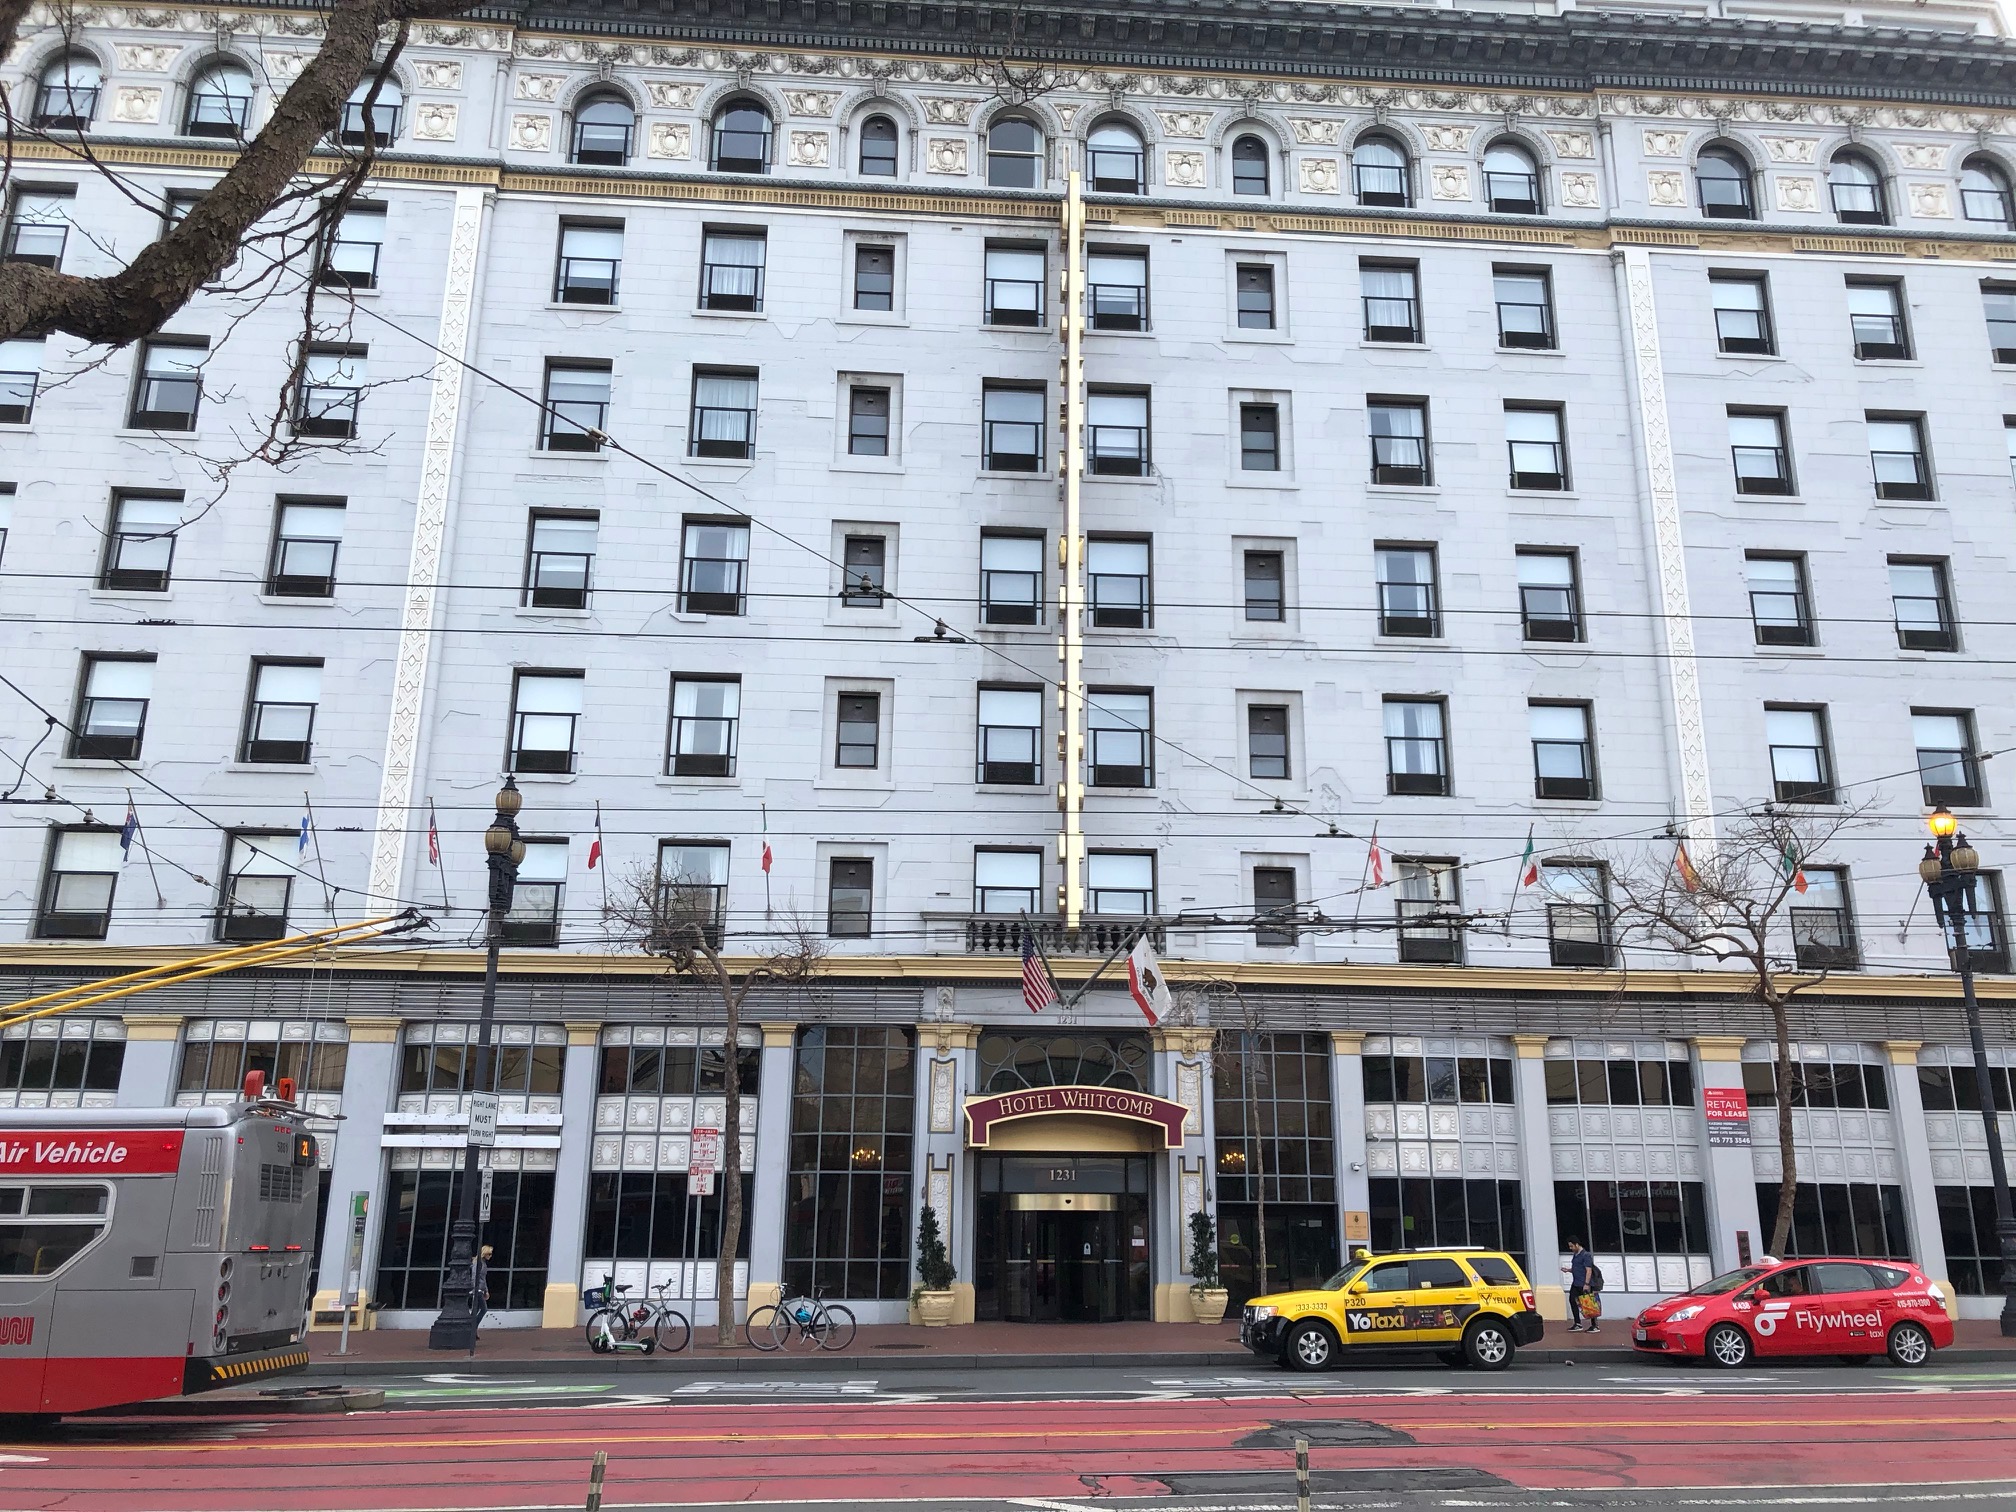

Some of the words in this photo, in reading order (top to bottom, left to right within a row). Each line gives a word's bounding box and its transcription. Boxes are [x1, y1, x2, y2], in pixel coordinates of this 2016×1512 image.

[1056, 1015, 1077, 1025] 1231
[486, 1102, 497, 1110] LANE
[999, 1094, 1056, 1116] HOTEL
[1060, 1090, 1154, 1116] WHITCOMB
[1706, 1100, 1742, 1109] RETAIL
[475, 1114, 492, 1124] MUST
[470, 1129, 481, 1137] TURN
[482, 1130, 494, 1138] RIGHT
[35, 1141, 127, 1163] Vehicle
[1050, 1169, 1076, 1181] 1231
[1345, 1298, 1366, 1307] P320
[1493, 1296, 1518, 1304] YELLOW
[1348, 1311, 1405, 1330] YoTaxi
[1795, 1310, 1883, 1333] Flywheel
[1869, 1330, 1884, 1338] taxi
